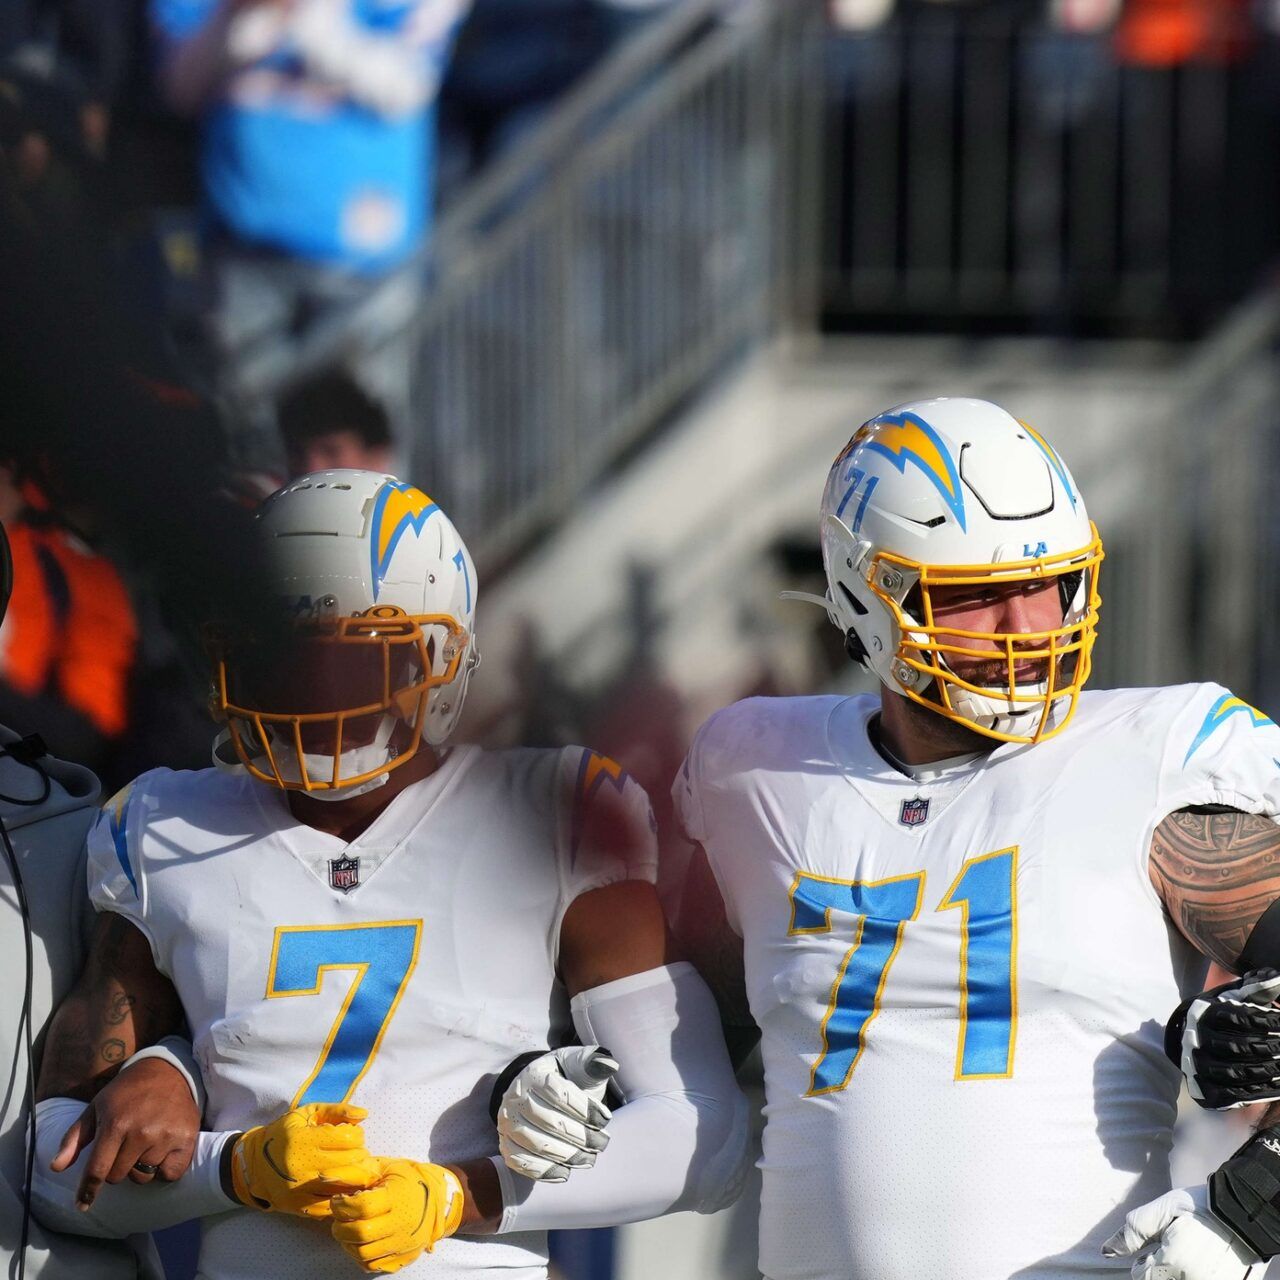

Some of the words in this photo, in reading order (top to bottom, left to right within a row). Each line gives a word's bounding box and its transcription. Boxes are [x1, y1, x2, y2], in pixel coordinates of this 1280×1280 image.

[835, 467, 880, 533] 71
[452, 548, 471, 614] 7
[1023, 541, 1049, 558] LA
[787, 844, 1020, 1099] 71
[265, 918, 424, 1111] 7
